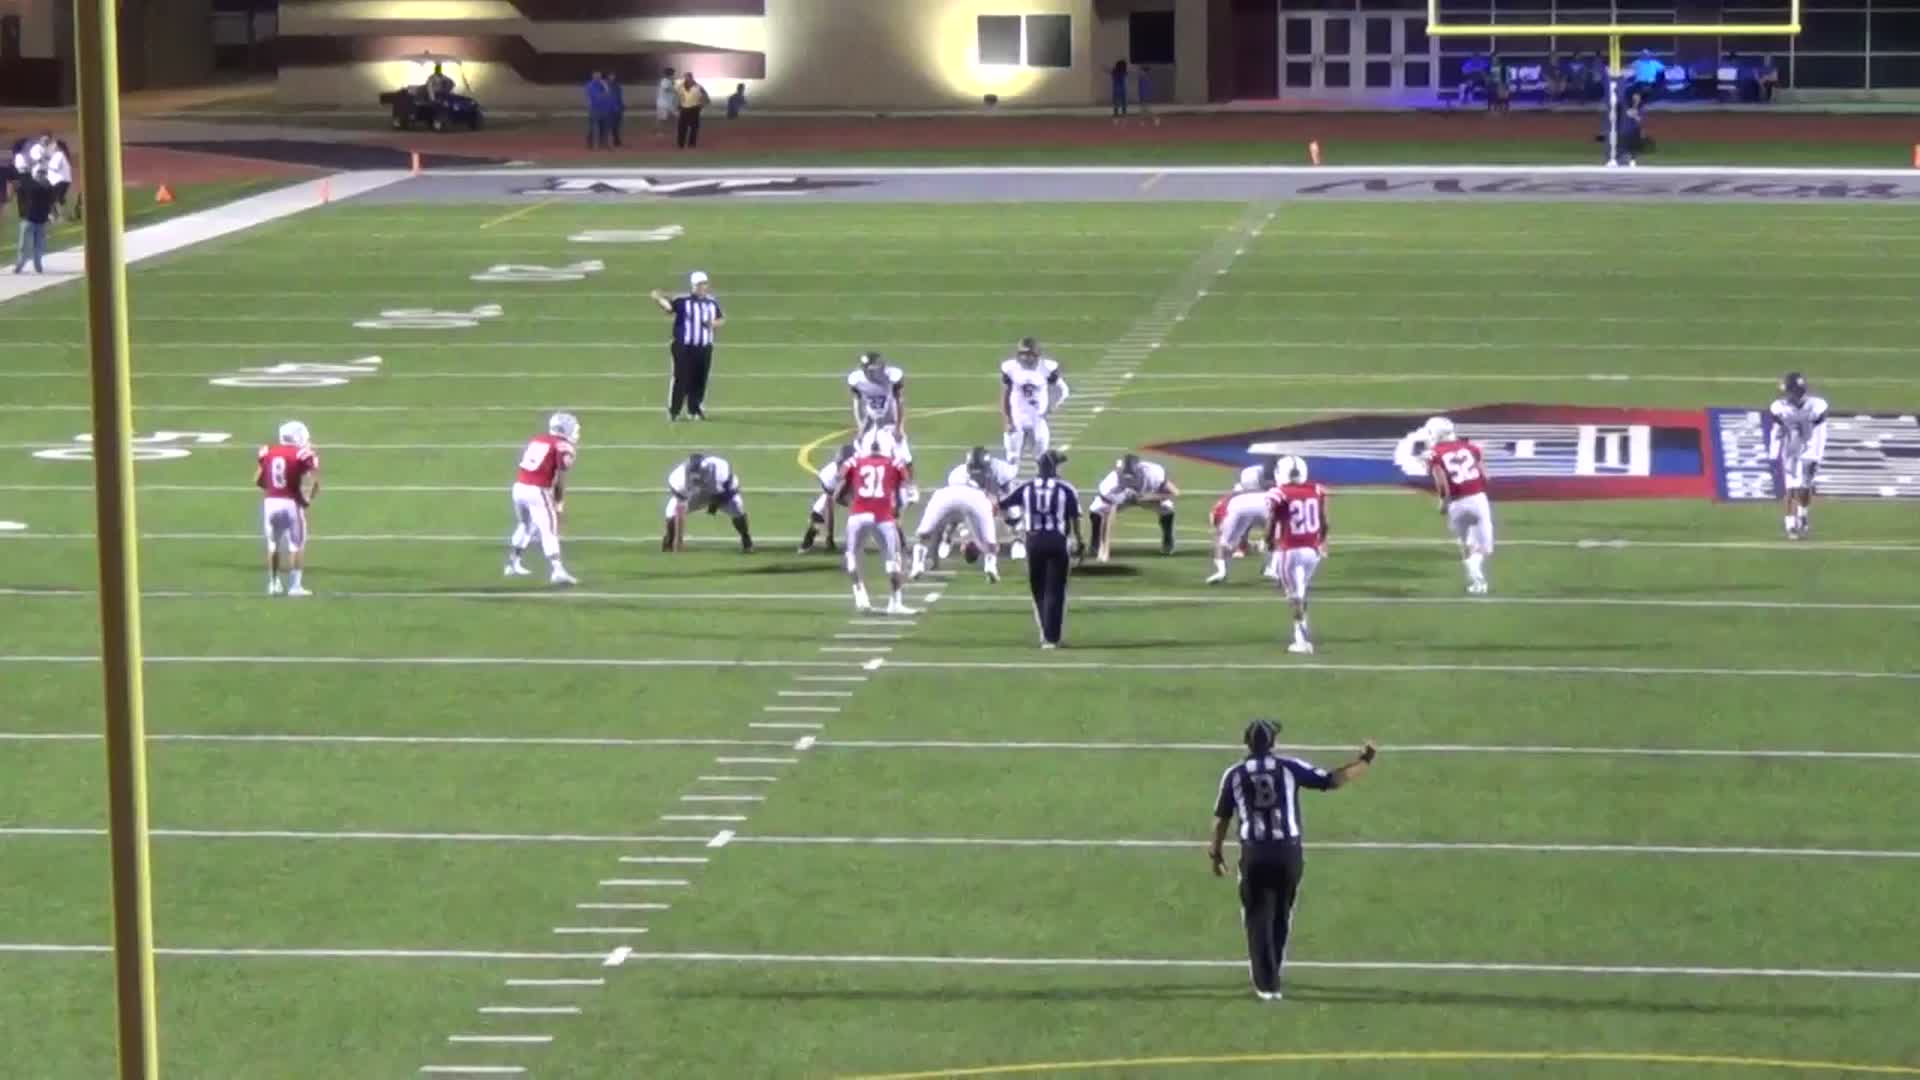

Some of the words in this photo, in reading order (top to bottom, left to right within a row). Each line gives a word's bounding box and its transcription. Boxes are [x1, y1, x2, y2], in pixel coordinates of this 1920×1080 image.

[271, 456, 288, 489] 8
[858, 464, 886, 498] 31
[1441, 448, 1481, 484] 52
[1289, 498, 1320, 535] 20
